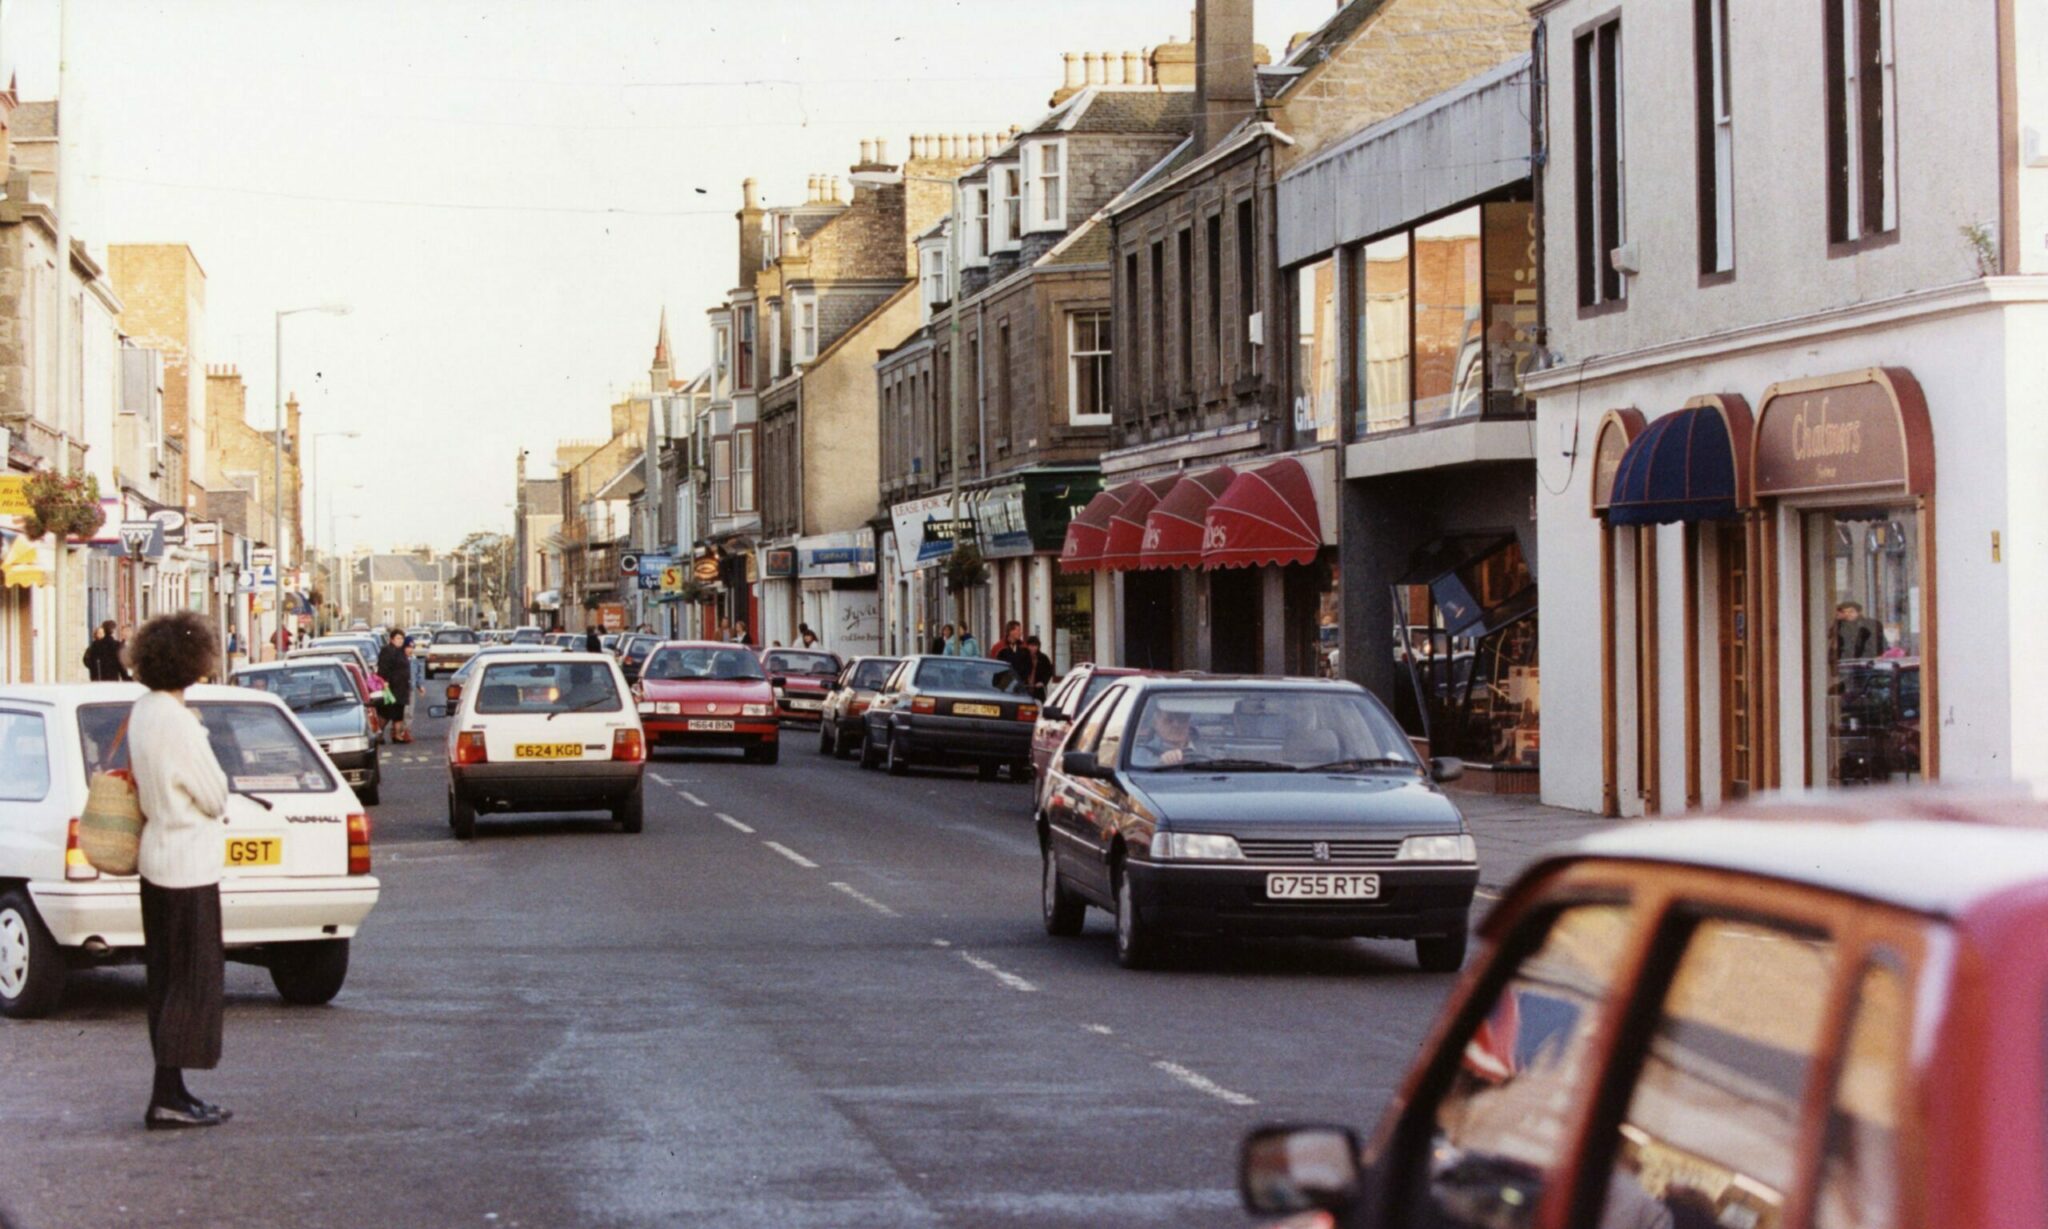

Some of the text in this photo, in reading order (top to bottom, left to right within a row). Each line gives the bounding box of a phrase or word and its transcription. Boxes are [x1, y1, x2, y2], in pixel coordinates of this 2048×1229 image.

[921, 497, 941, 512] FOR
[516, 745, 552, 758] C624
[286, 815, 341, 824] VAUXHALL
[230, 841, 273, 862] GST
[1271, 876, 1377, 895] G755 RTS
